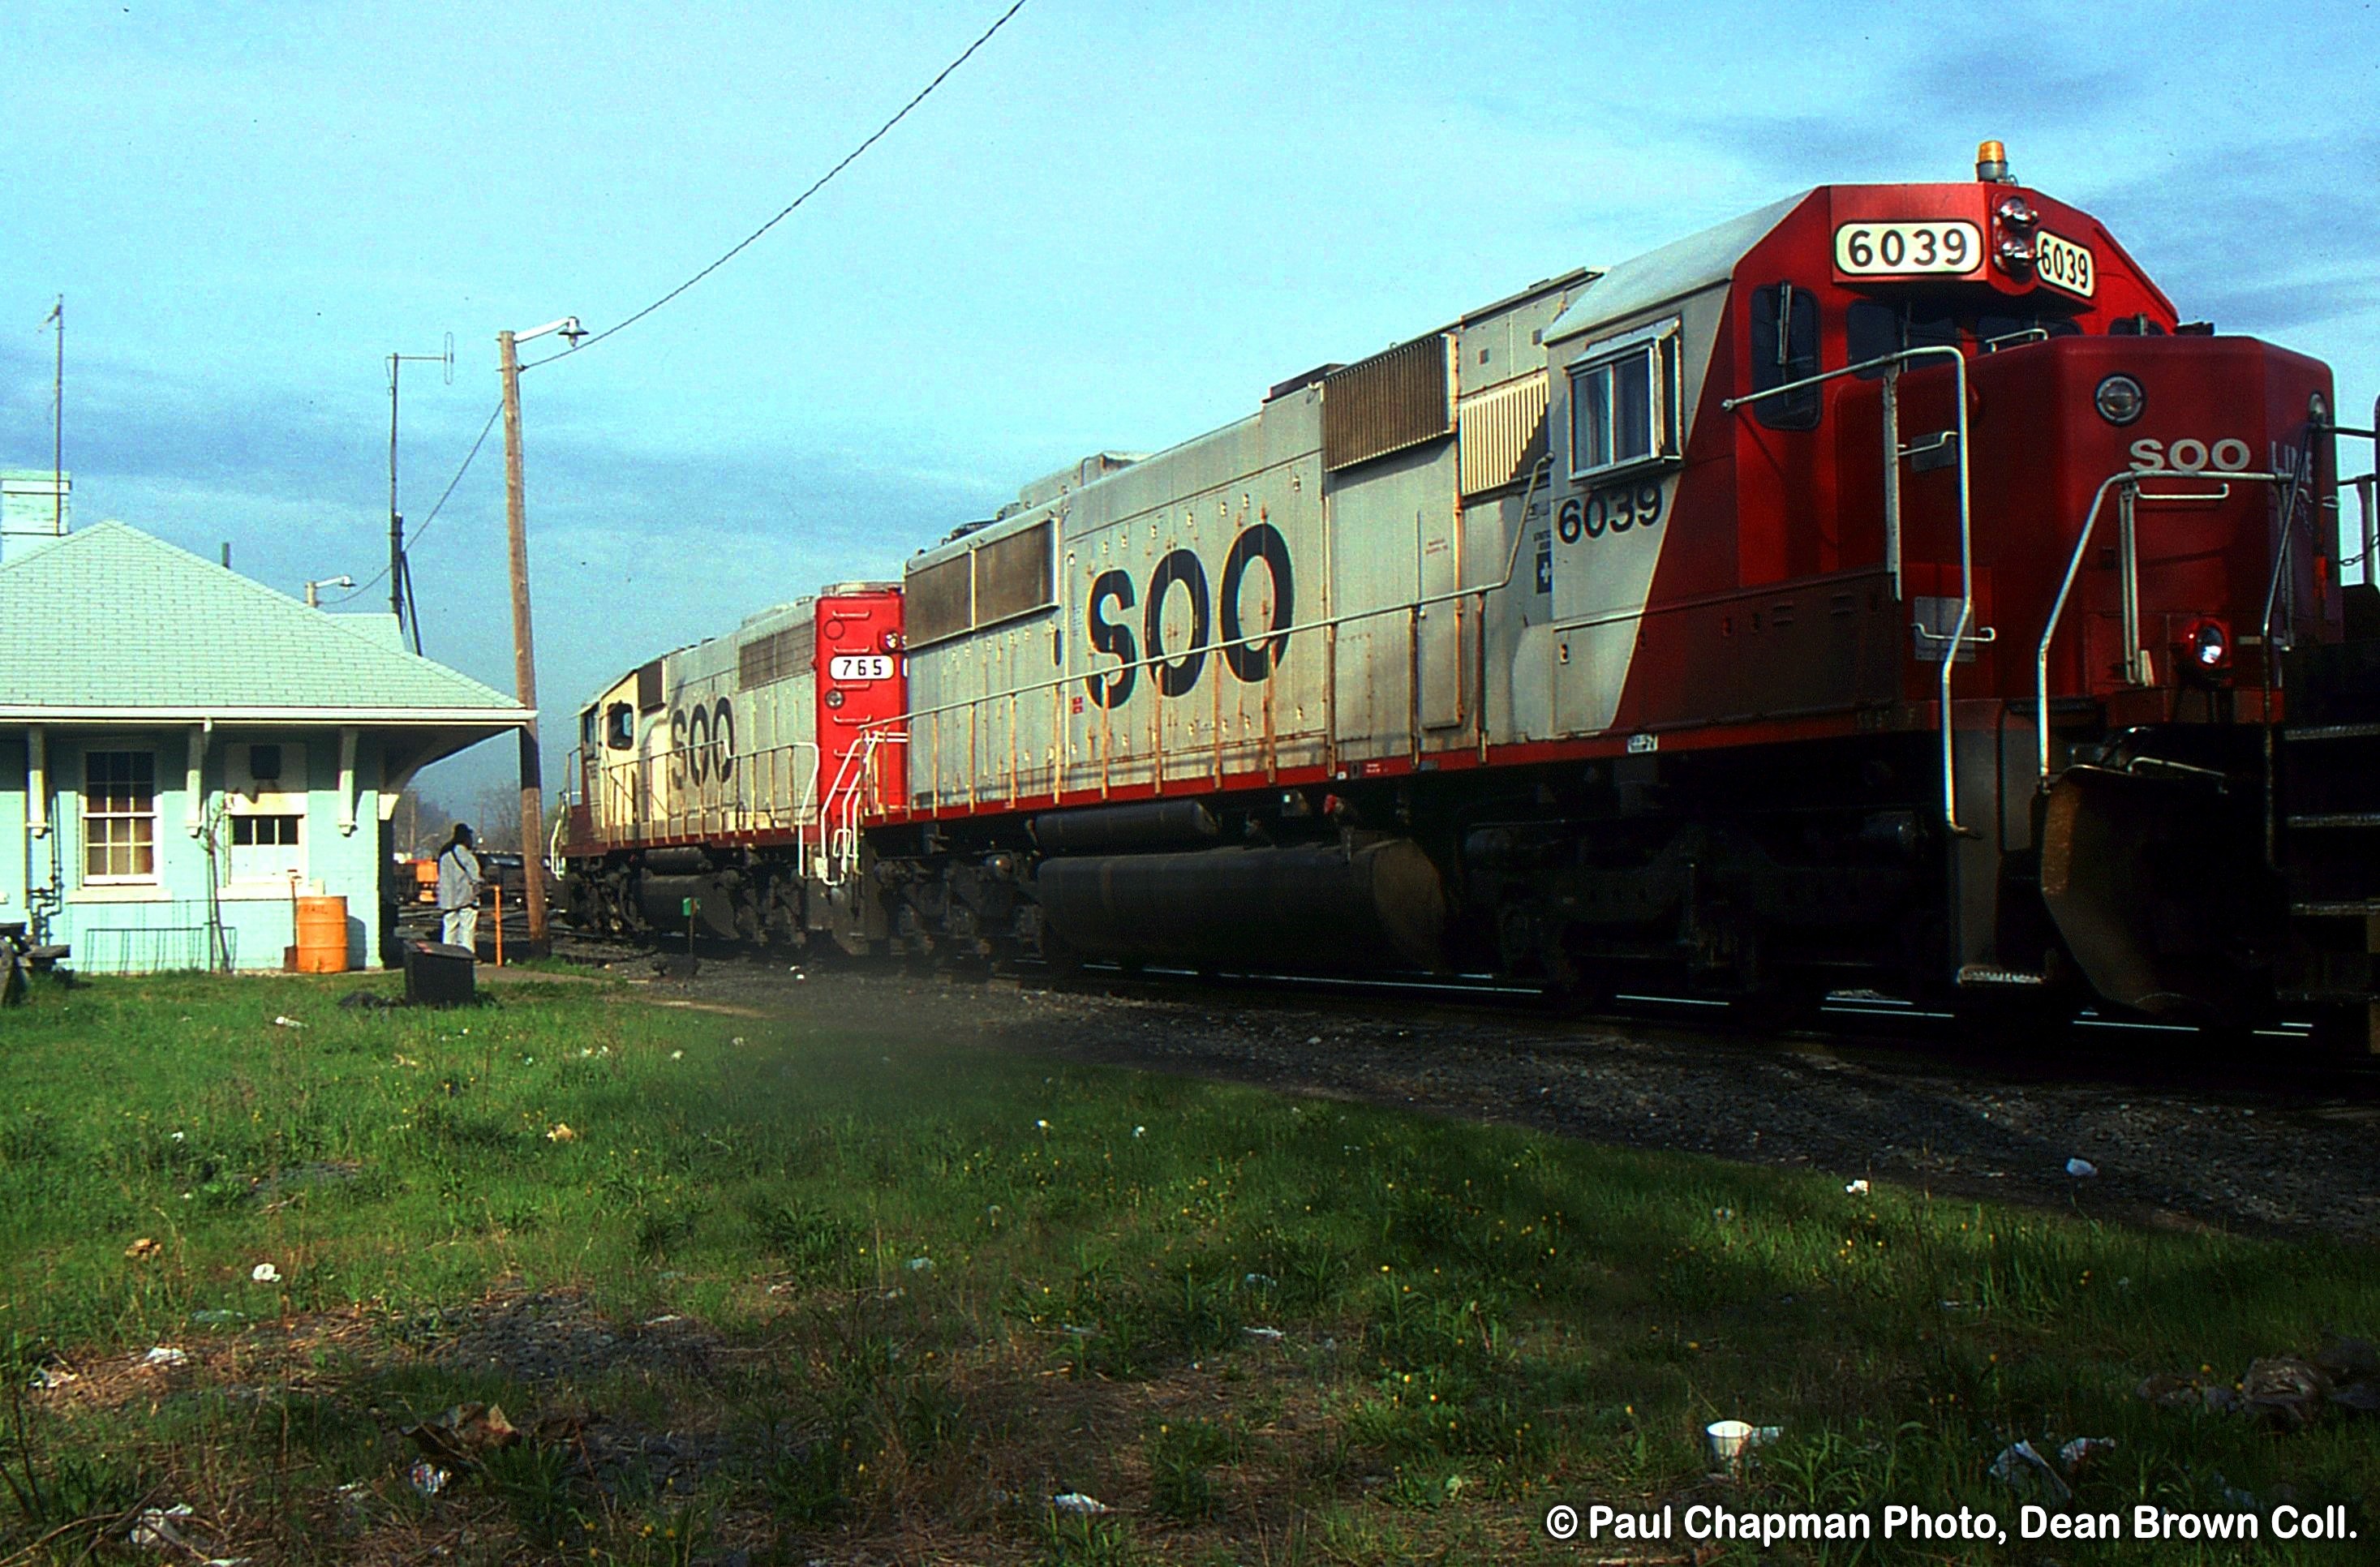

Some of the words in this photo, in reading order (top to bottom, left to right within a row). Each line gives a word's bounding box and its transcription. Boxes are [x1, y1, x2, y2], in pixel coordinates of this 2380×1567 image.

[1847, 228, 1968, 268] 6039
[2040, 236, 2090, 291] 6039
[2129, 438, 2251, 472] SOO
[1557, 484, 1664, 544] 6039
[1085, 522, 1295, 710] SOO
[842, 658, 883, 676] 765
[671, 697, 734, 791] SOO
